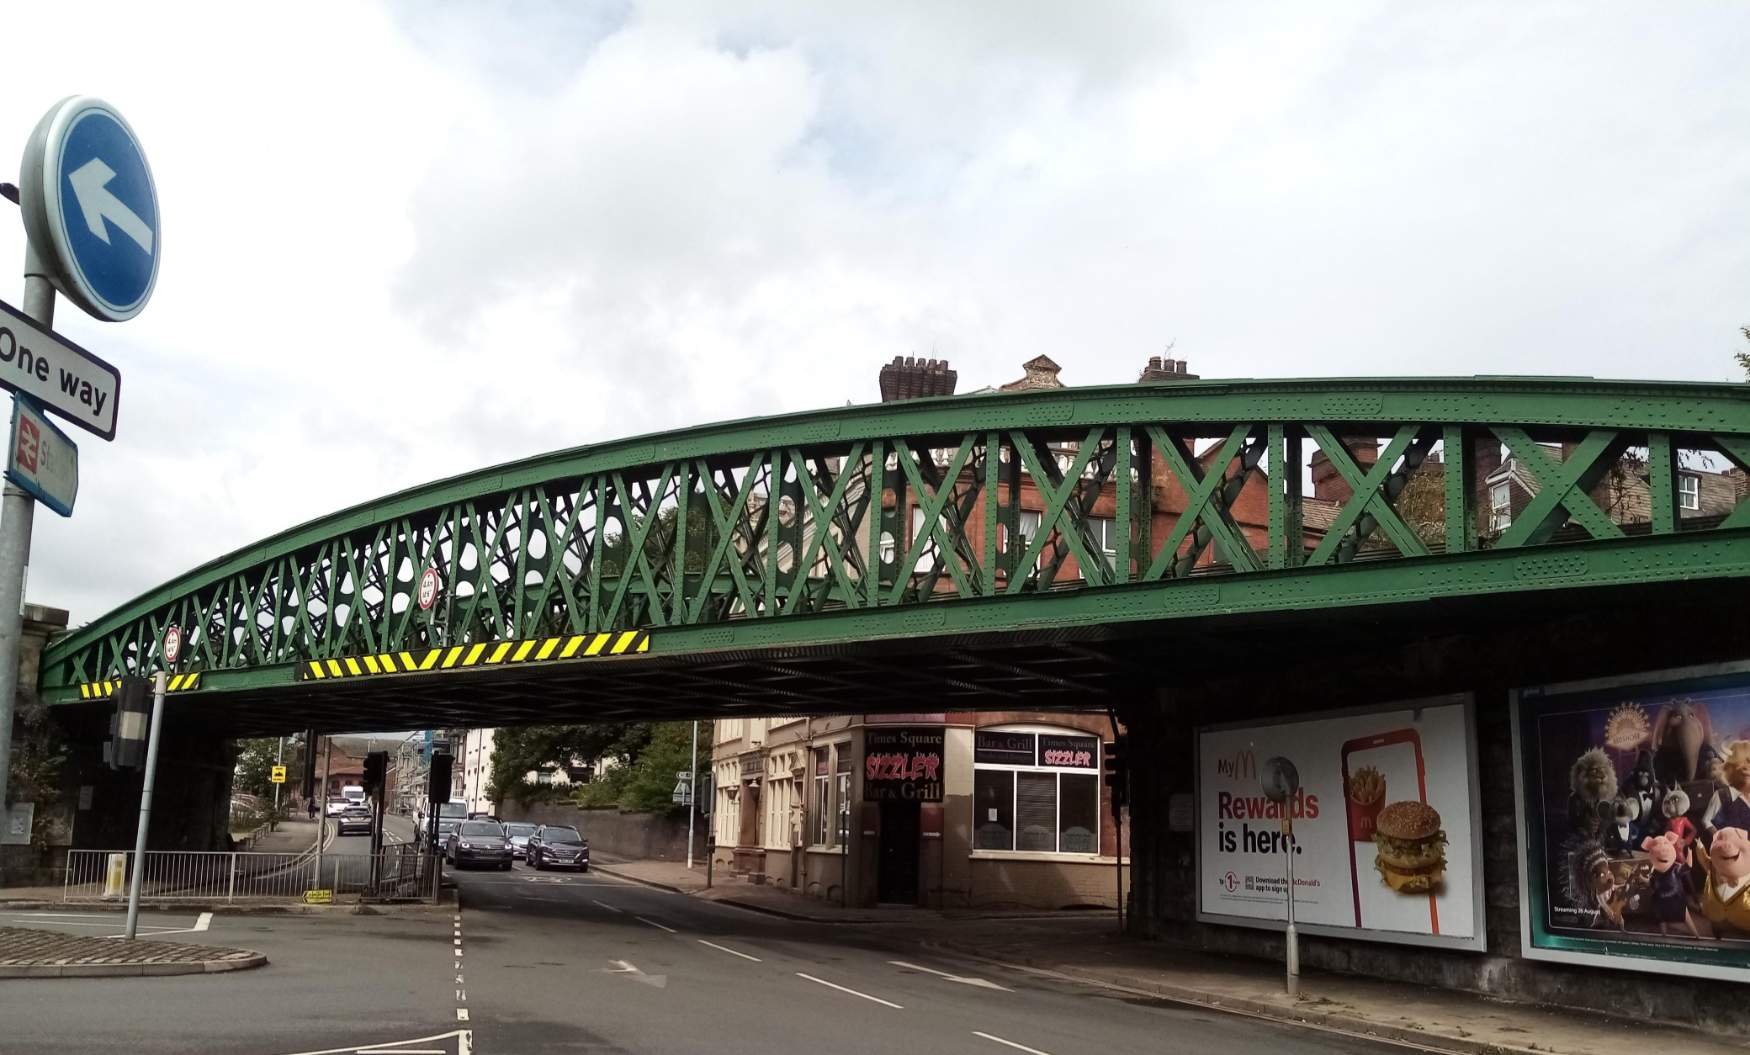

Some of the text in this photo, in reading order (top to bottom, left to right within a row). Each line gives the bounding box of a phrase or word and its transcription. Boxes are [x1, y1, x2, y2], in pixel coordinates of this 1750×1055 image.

[0, 326, 107, 417] One way
[867, 730, 942, 747] Times Square
[977, 735, 998, 748] Bar
[1007, 737, 1033, 750] Grill
[1067, 738, 1095, 750] Square
[866, 752, 940, 781] SIZZLER
[1044, 749, 1091, 767] SIZZLER
[1217, 759, 1234, 778] My
[901, 782, 940, 800] Grill
[1218, 822, 1303, 855] is here.
[1255, 876, 1280, 885] Download
[1292, 878, 1320, 887] cDonald's
[1255, 885, 1265, 893] app
[1554, 905, 1578, 915] Streaming
